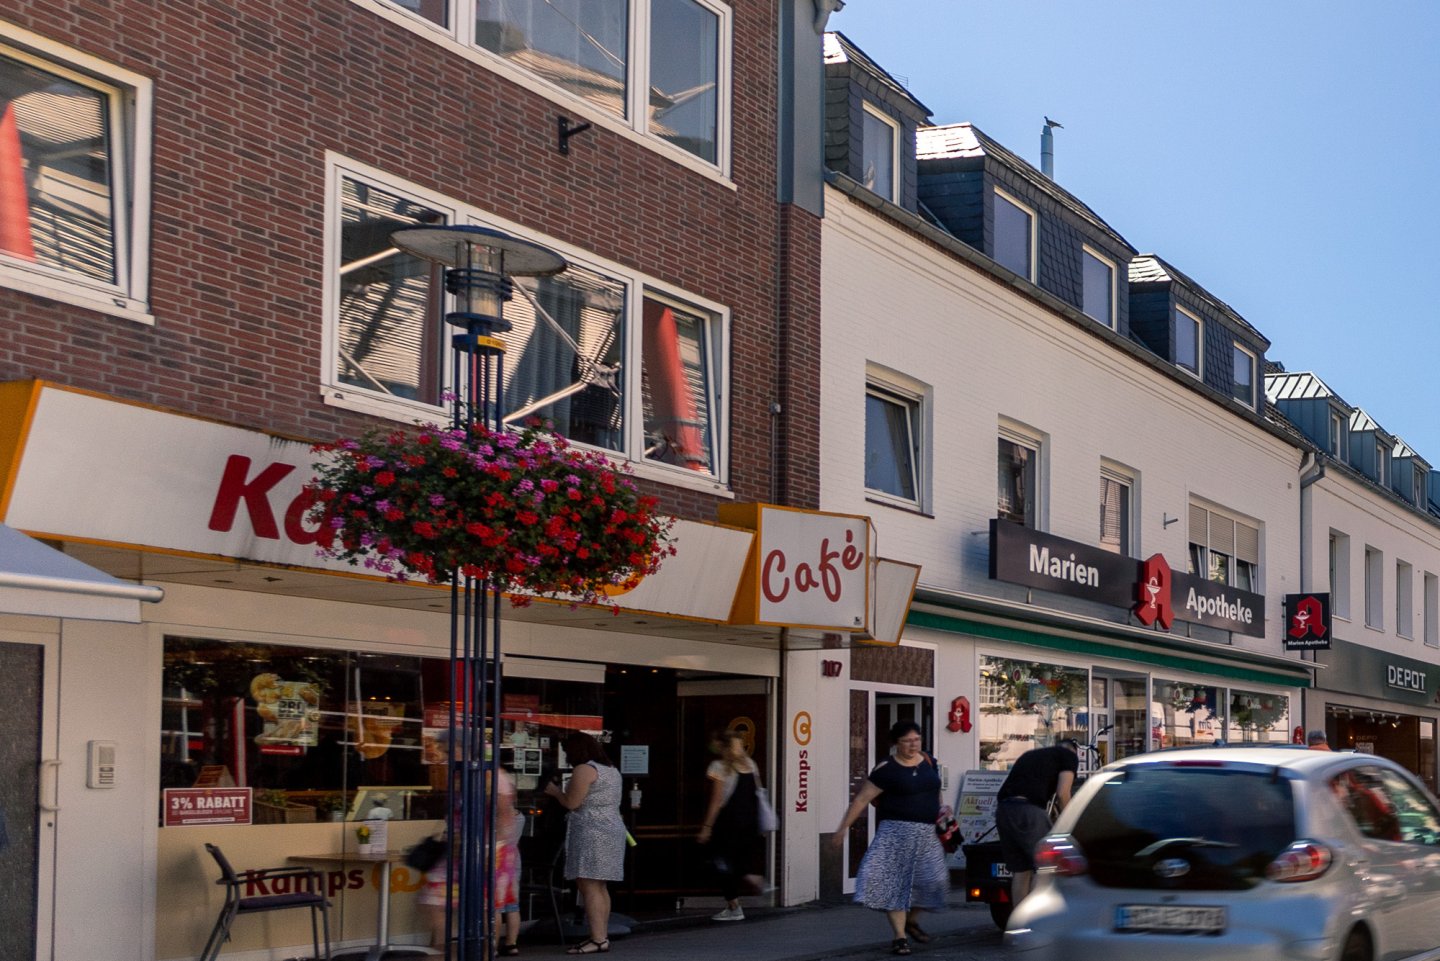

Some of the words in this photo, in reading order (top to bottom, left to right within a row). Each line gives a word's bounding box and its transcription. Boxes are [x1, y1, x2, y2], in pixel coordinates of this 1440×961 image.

[761, 529, 864, 603] Café
[1029, 543, 1099, 588] Marien
[1186, 586, 1253, 624] Apotheke
[1388, 665, 1426, 690] DEPOT
[171, 797, 193, 810] 3%
[196, 796, 246, 809] RABATT
[796, 750, 811, 813] Kamps
[245, 868, 364, 897] Kamps
